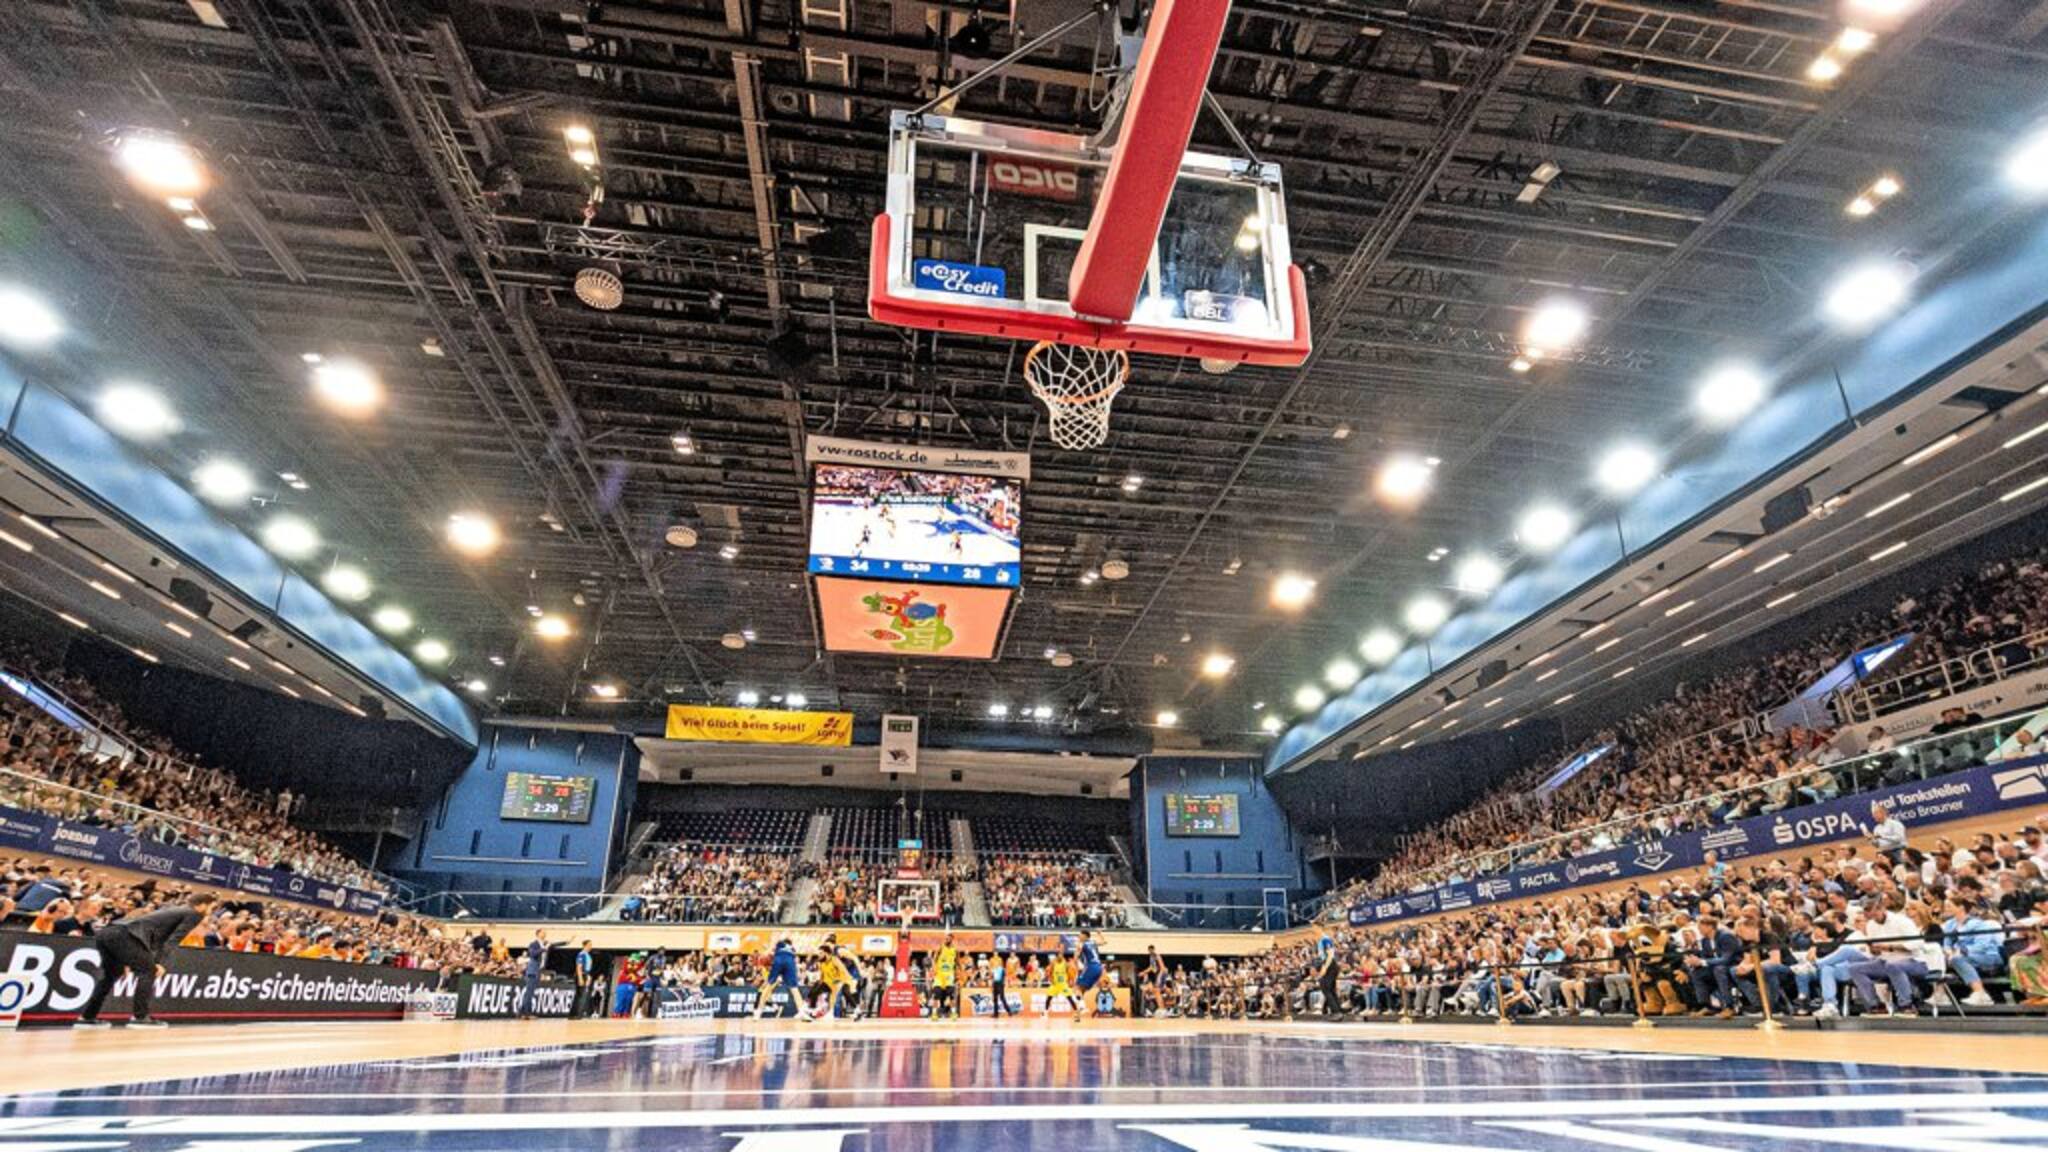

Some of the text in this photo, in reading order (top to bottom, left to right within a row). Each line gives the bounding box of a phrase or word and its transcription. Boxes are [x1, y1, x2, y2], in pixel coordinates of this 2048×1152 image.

[943, 277, 999, 295] Credit
[817, 444, 928, 465] vw-rostock.de
[850, 560, 869, 572] 34
[682, 718, 806, 733] Viel Glück beim Spiel!
[1896, 783, 1972, 806] Tankstellen
[1917, 800, 1963, 817] Brauner
[1795, 812, 1857, 840] OSPA
[467, 983, 512, 1013] NEUE
